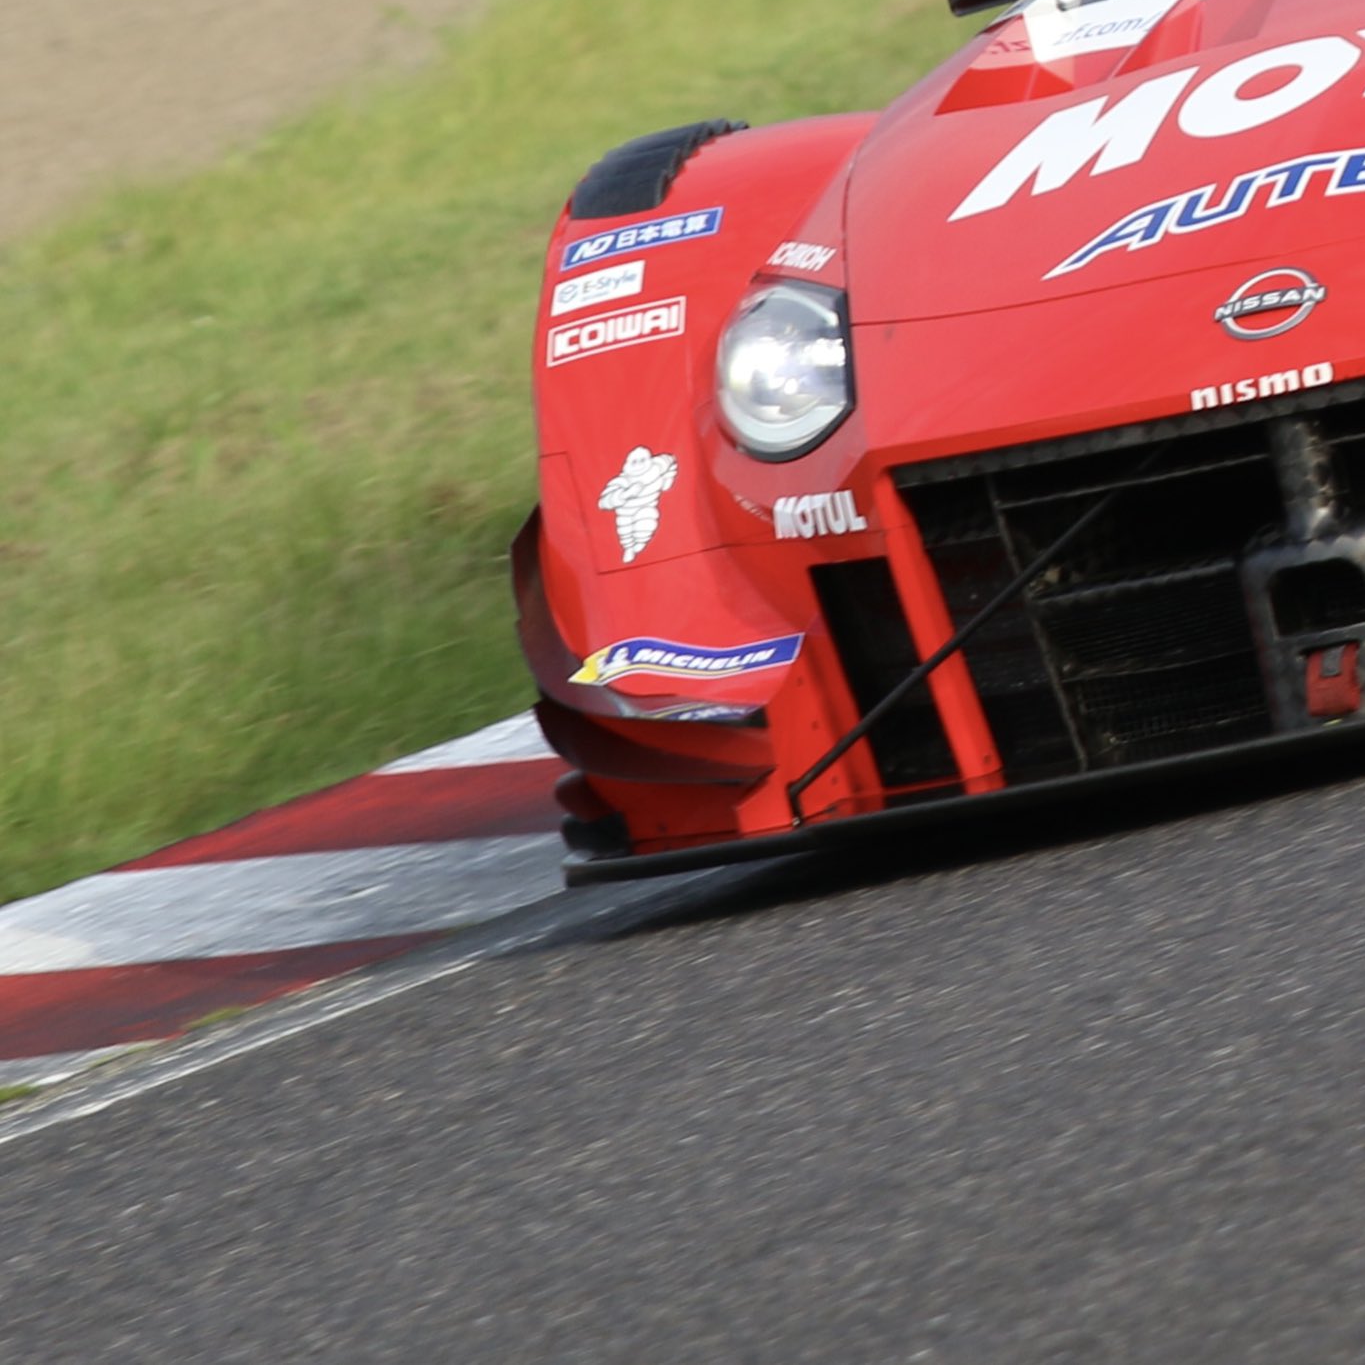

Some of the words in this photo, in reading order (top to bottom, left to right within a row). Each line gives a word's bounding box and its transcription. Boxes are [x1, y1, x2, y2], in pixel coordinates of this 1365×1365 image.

[1214, 285, 1326, 319] NISSAN
[553, 304, 679, 357] KOIWAI
[772, 490, 868, 539] MOTUL
[632, 647, 777, 671] MICHELIN
